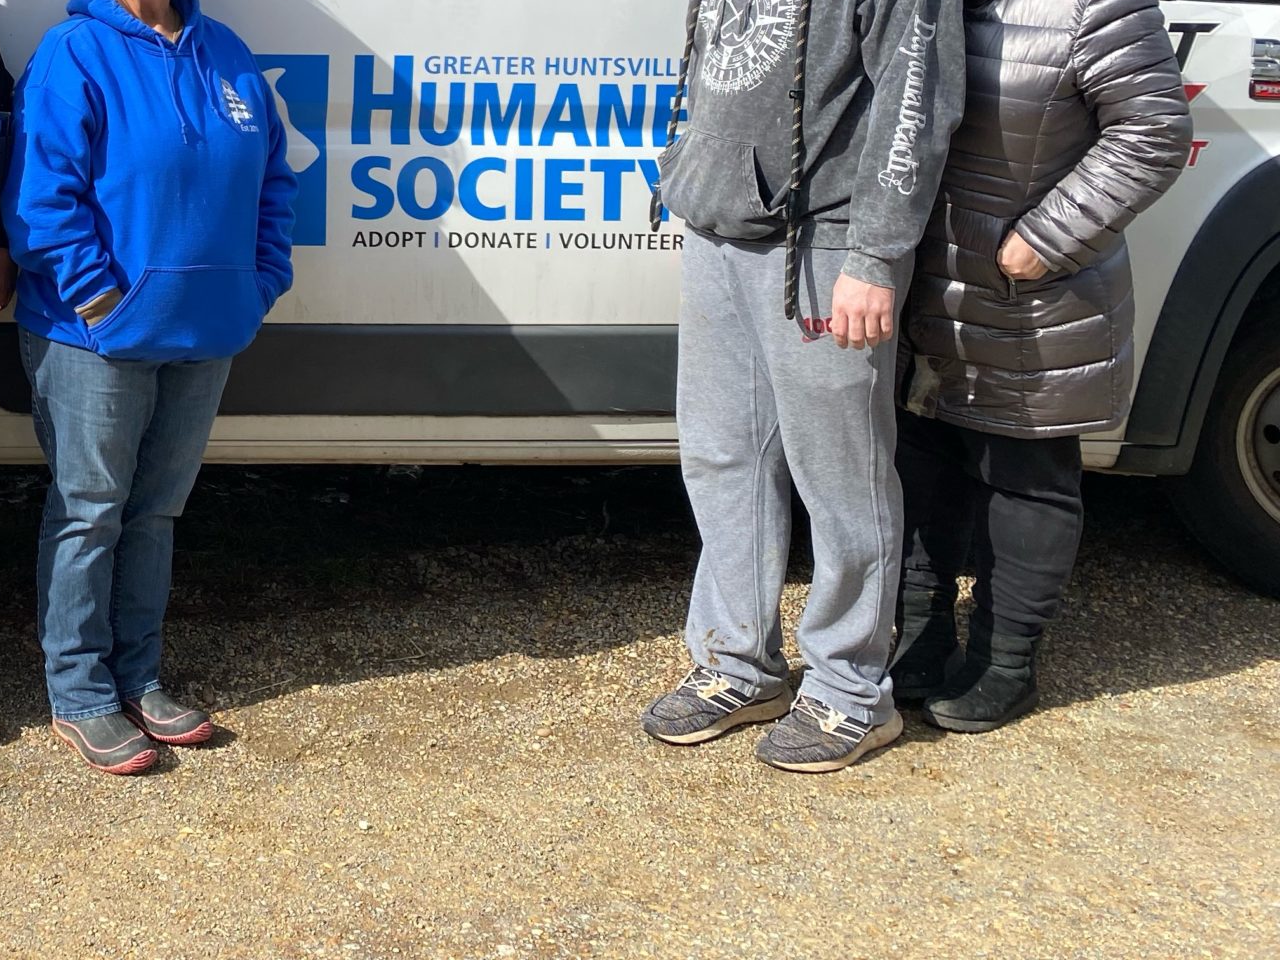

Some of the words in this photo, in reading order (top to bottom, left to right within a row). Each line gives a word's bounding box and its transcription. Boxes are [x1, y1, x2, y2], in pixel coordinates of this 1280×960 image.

[424, 55, 535, 76] GREATER
[899, 14, 937, 107] Daytona
[350, 54, 688, 149] HUMANE
[887, 105, 926, 173] Beach
[351, 230, 427, 249] ADOPT
[448, 231, 537, 250] DONATE
[560, 232, 685, 251] VOLUNTEER
